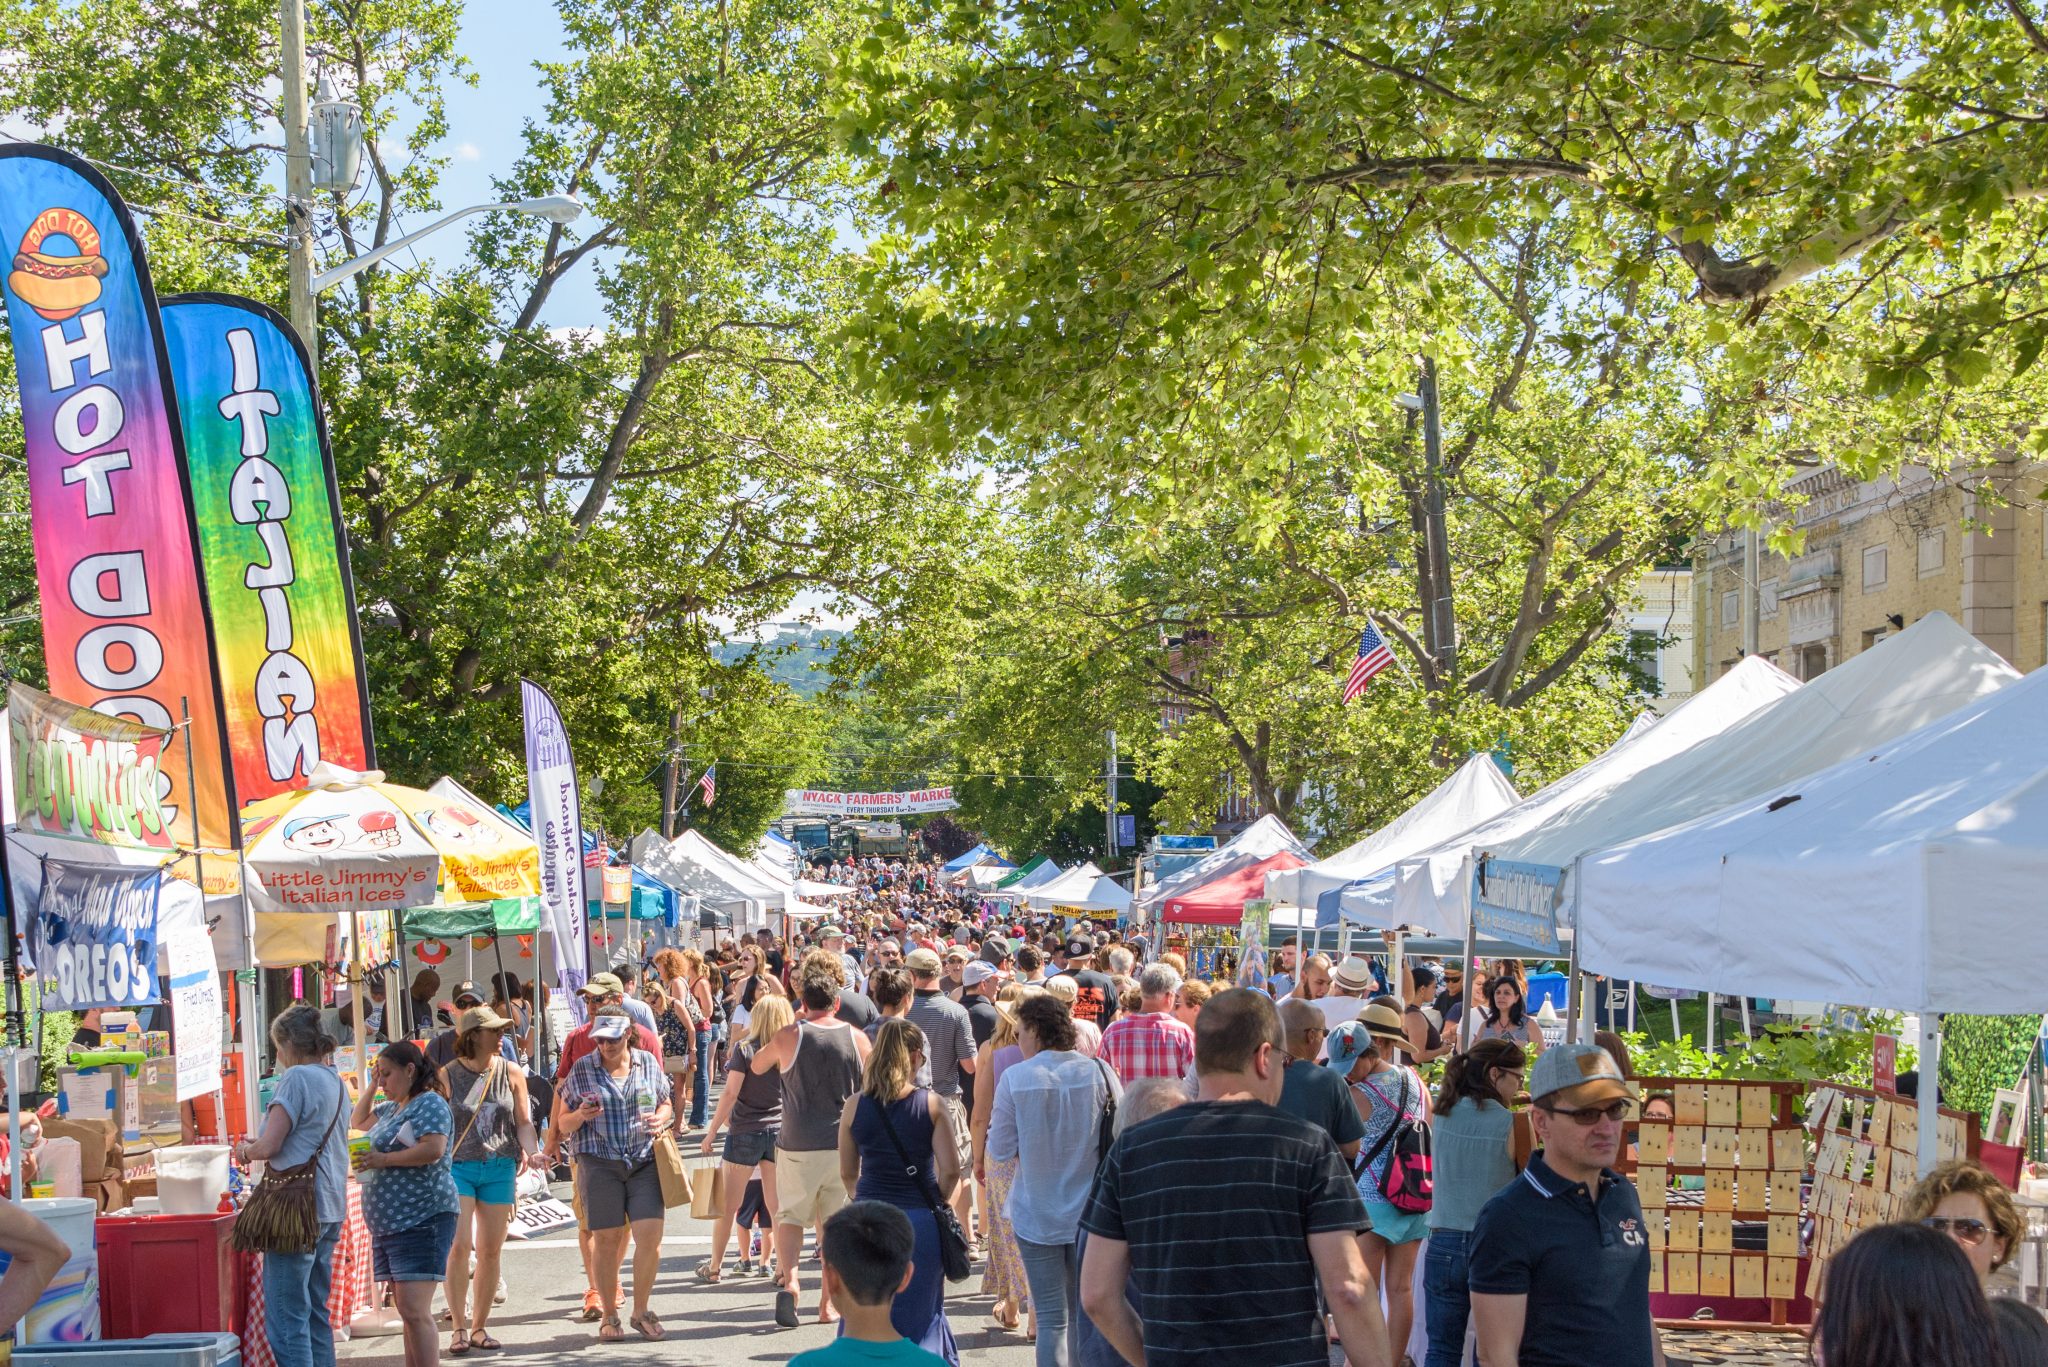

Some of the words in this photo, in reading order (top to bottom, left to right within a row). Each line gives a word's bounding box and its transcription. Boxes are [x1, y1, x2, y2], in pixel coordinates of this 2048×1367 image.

[802, 791, 841, 804] NYACK
[846, 793, 906, 805] FARMERS'
[910, 788, 951, 803] MARKE
[846, 806, 865, 814] EVERY
[866, 806, 894, 814] THURSDAY
[445, 862, 479, 878] Little
[480, 857, 531, 878] Jimmy's
[259, 869, 326, 887] Little
[330, 866, 426, 888] Jimmy's
[454, 879, 493, 894] Italian
[495, 878, 519, 892] Ices
[282, 888, 353, 904] Italian
[358, 886, 406, 902] Ices
[1054, 904, 1082, 914] STERLIN
[57, 943, 150, 1003] OREOS
[516, 1205, 571, 1228] BBQ
[1623, 1231, 1644, 1246] CA
